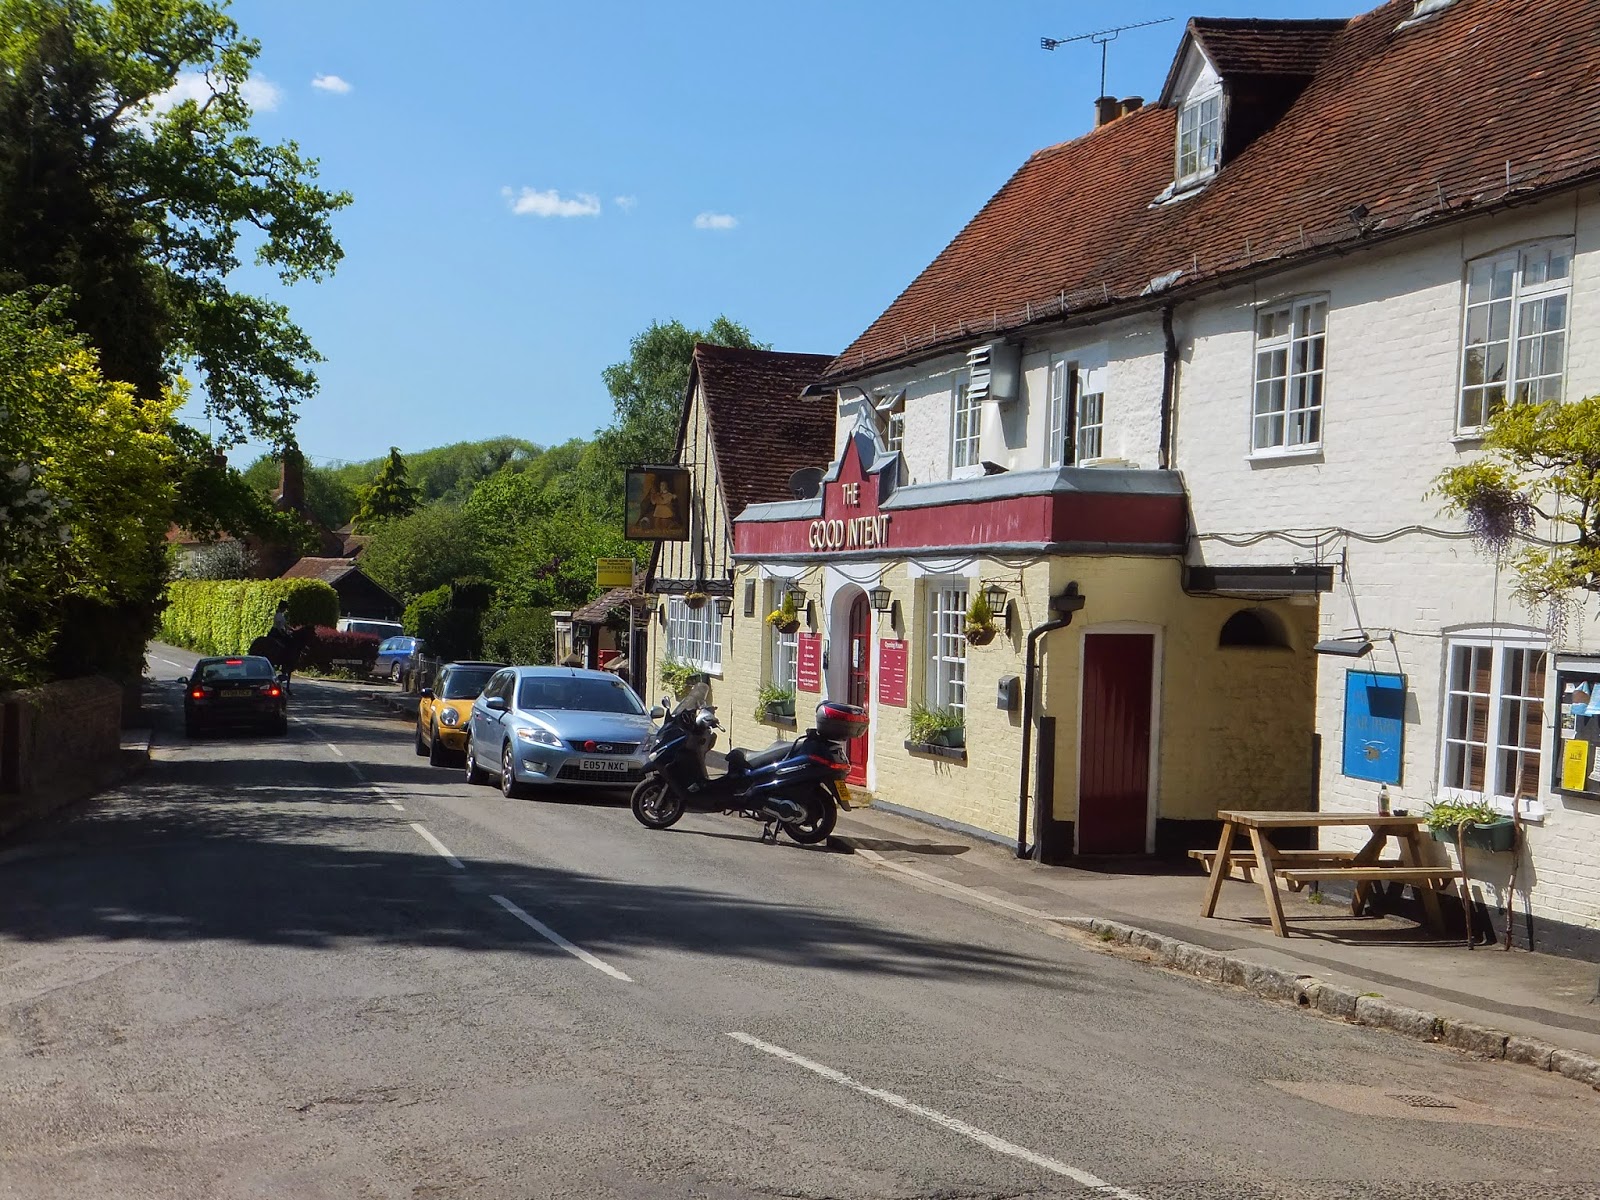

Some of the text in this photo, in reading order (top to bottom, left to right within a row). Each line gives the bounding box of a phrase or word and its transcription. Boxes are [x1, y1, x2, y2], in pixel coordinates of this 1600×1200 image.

[842, 482, 858, 505] THE
[808, 514, 890, 549] GOOD INTENT
[583, 760, 625, 770] EO57 NXC
